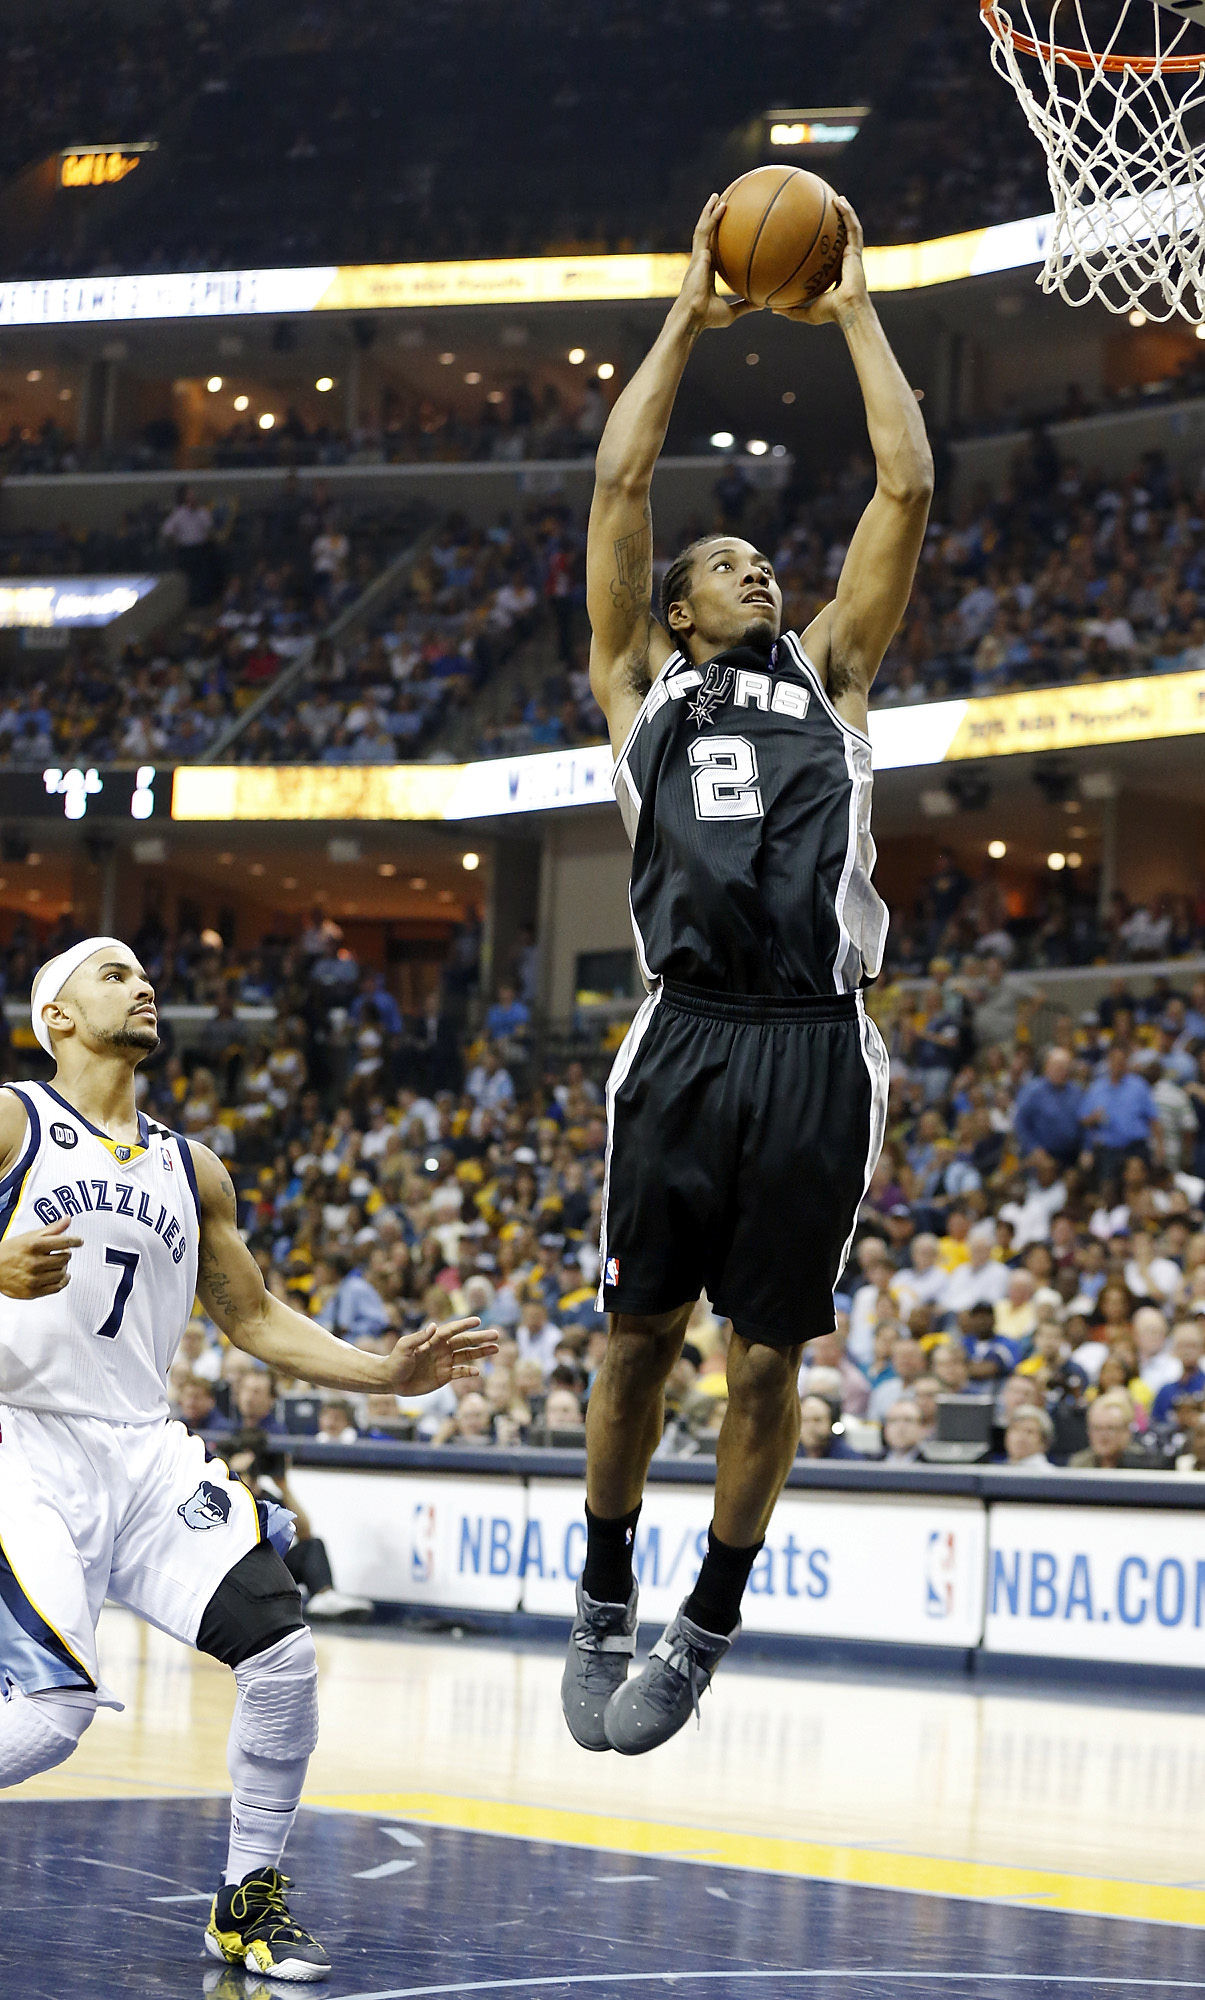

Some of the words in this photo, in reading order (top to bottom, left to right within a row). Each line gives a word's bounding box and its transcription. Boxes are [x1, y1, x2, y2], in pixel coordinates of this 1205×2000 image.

[646, 664, 811, 724] SPURS
[687, 735, 764, 821] 2
[34, 1180, 187, 1264] GRIZZLIES
[96, 1246, 141, 1340] 7
[991, 1549, 1205, 1629] NBA.CO
